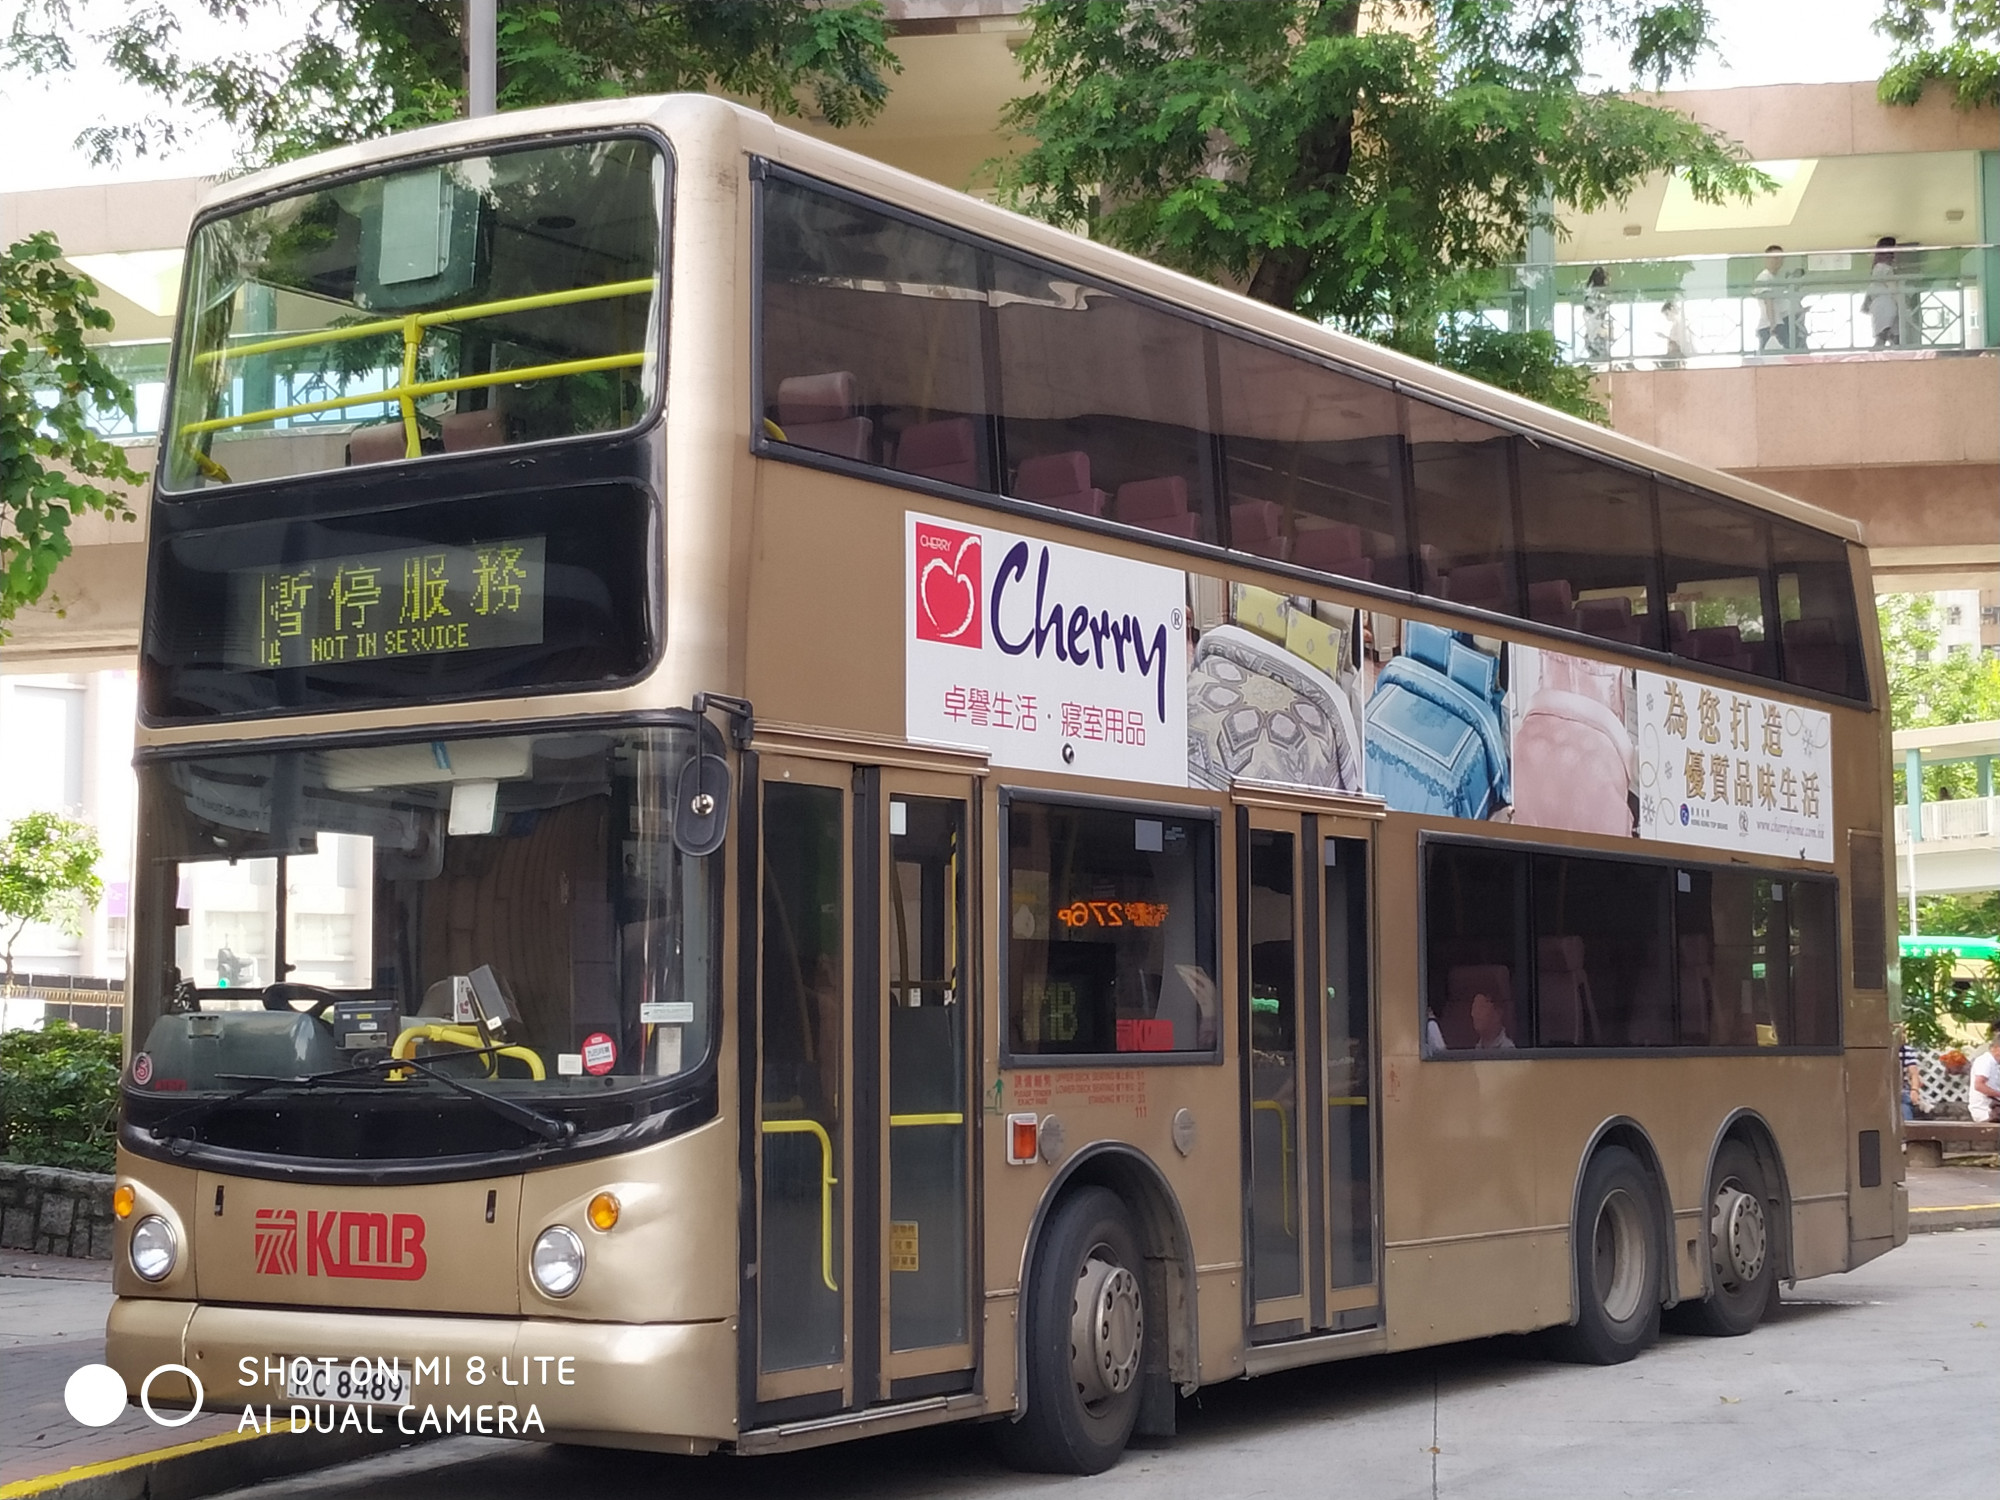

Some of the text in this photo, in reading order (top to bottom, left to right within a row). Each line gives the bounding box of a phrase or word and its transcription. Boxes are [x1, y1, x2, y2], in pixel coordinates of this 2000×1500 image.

[920, 534, 952, 552] CHERRY
[311, 635, 349, 662] NOT
[356, 632, 377, 657] IN
[384, 623, 469, 654] SERVICE
[991, 540, 1167, 724] Cherry
[1663, 680, 1784, 757] 為您打造
[1684, 747, 1820, 819] 優質品味生活
[1135, 1106, 1147, 1118] 111
[307, 1210, 427, 1281] KMB
[295, 1367, 403, 1402] KC 8489
